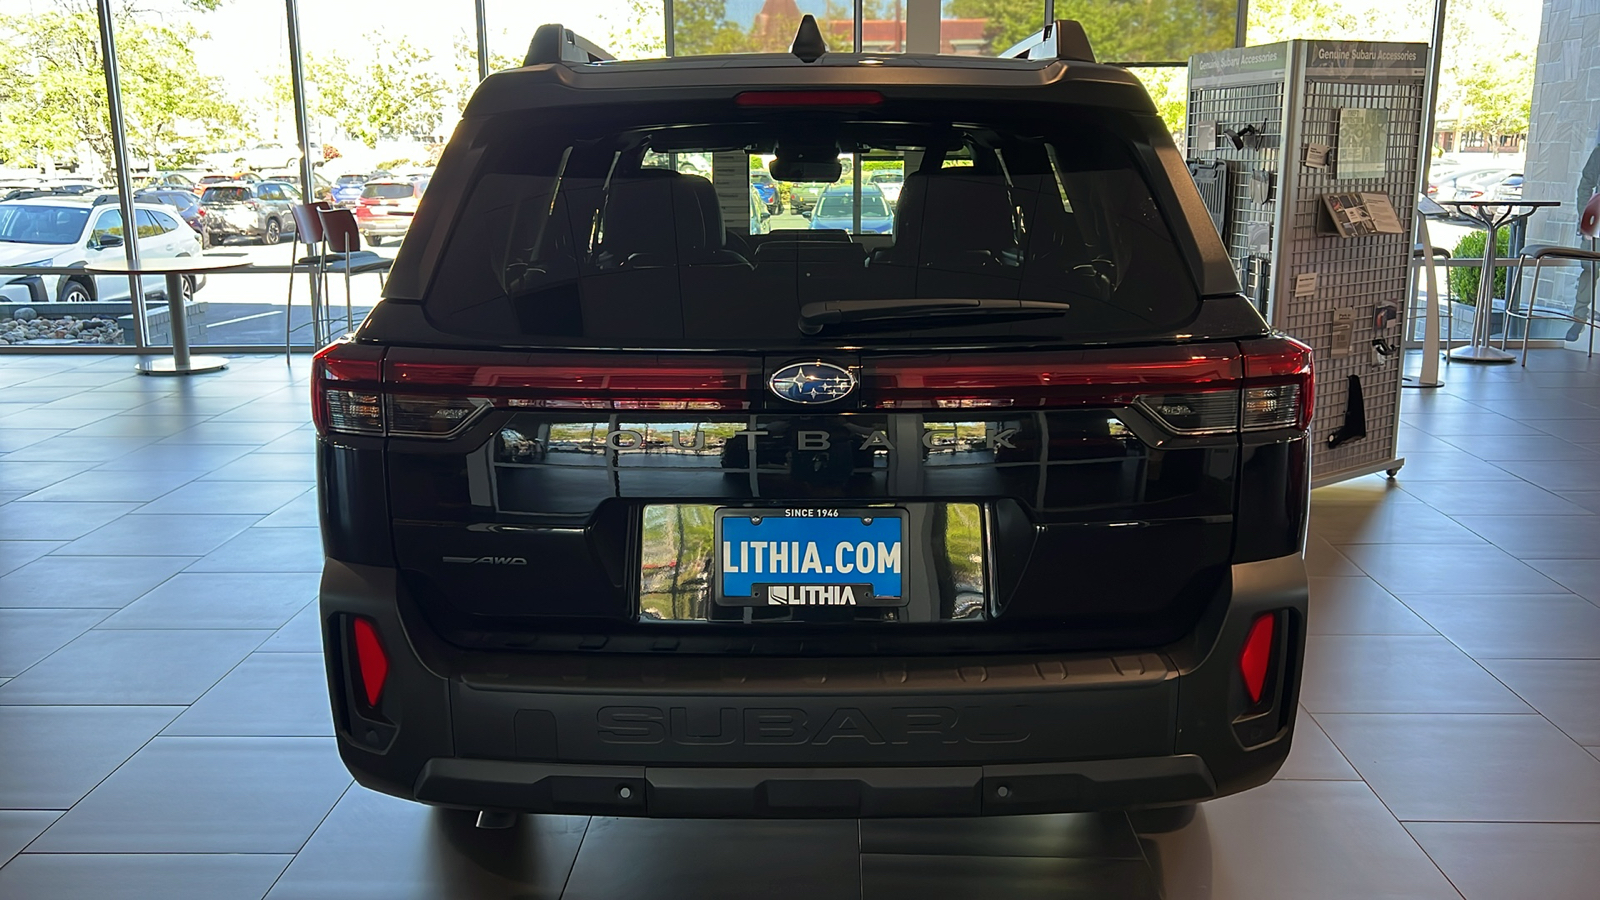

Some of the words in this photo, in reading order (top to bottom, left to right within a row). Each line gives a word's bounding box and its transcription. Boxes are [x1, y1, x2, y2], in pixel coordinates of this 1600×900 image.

[1221, 56, 1240, 68] Subaru
[1241, 51, 1278, 65] Accessories
[1318, 48, 1350, 60] Genuine
[1351, 49, 1377, 60] Subaru
[1377, 50, 1417, 61] Accessories
[605, 430, 1018, 451] OUTBACK
[785, 509, 814, 518] SINCE
[816, 509, 839, 518] 1946
[474, 556, 528, 565] AWD
[723, 541, 901, 574] LITHIA.COM
[788, 585, 857, 605] LITHIA
[597, 705, 1031, 746] SUBARU
